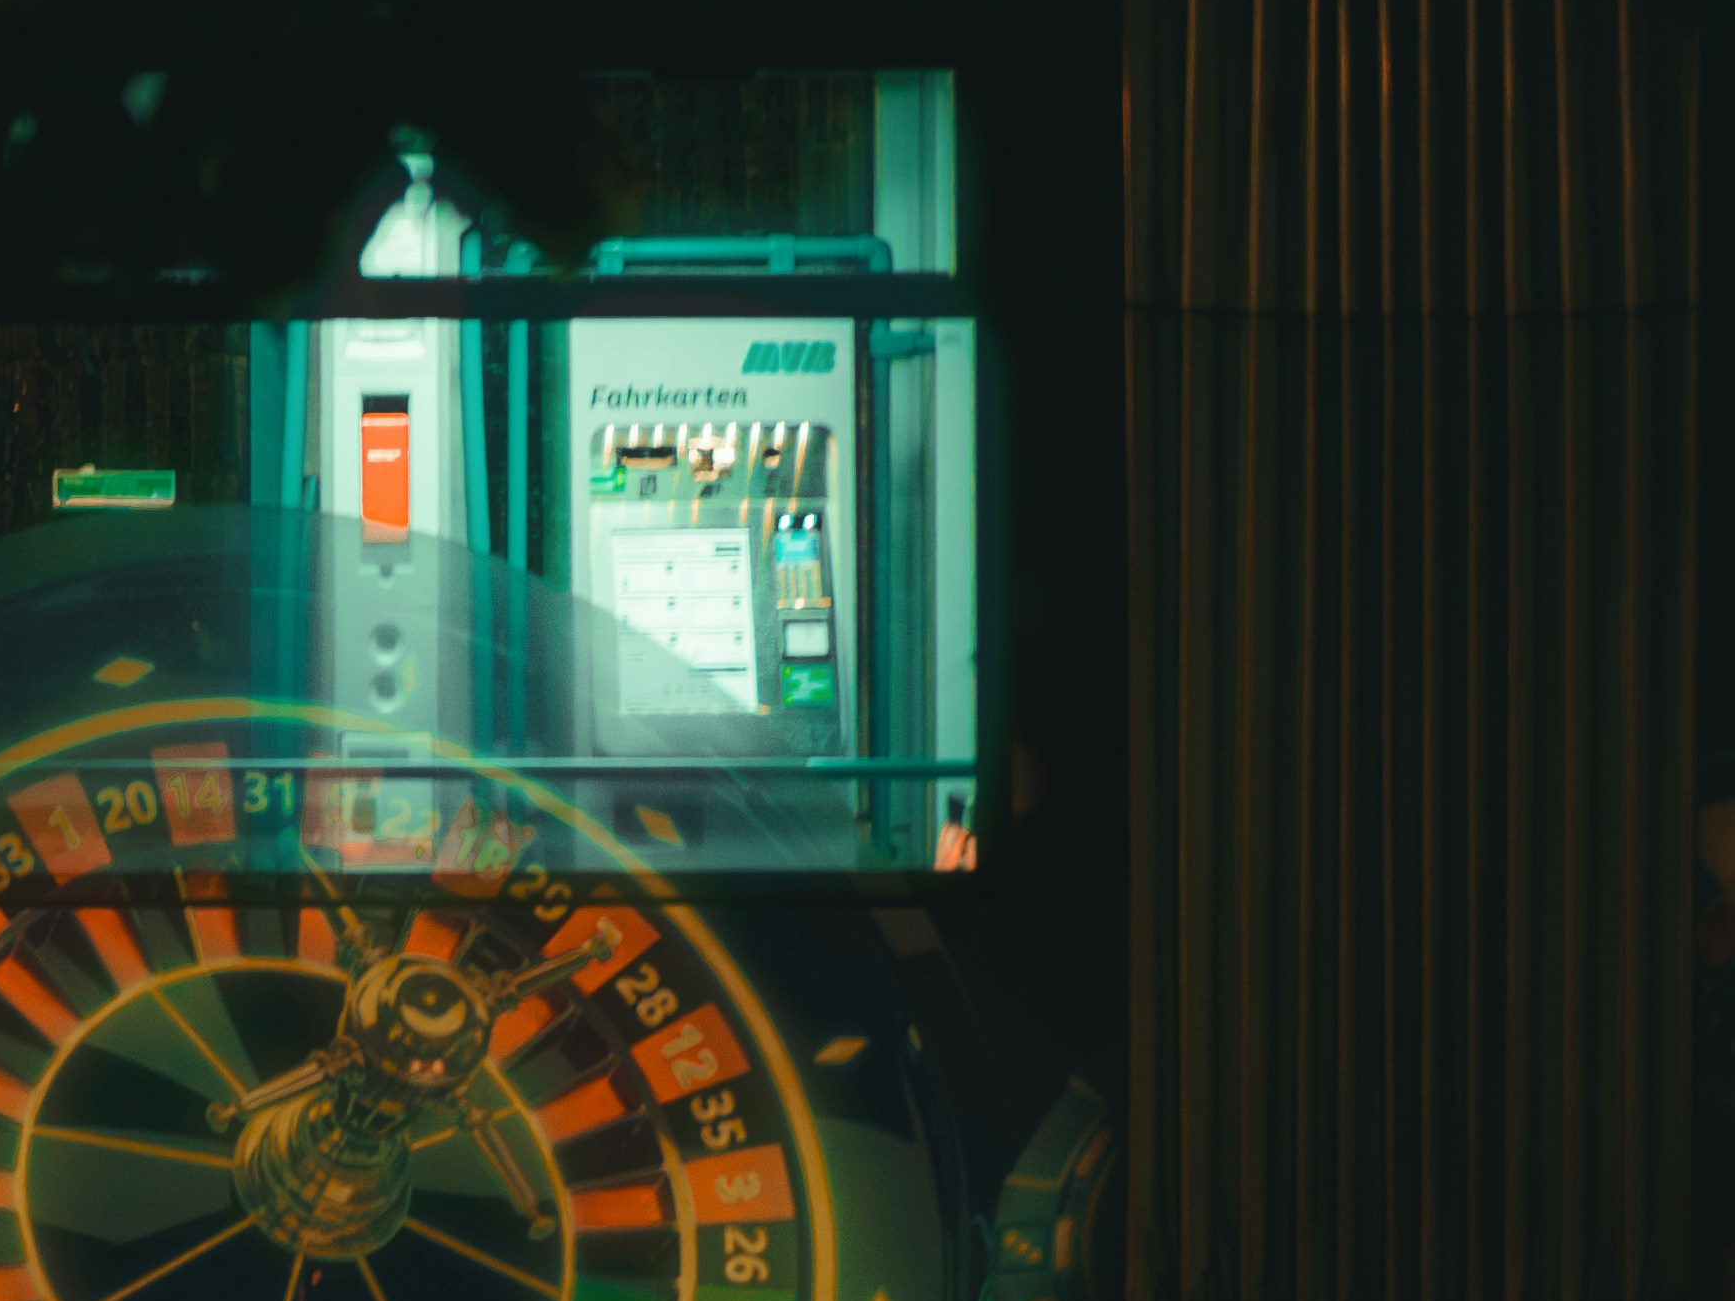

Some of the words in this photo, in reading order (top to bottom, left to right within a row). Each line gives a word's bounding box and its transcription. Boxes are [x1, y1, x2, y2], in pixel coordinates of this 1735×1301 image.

[590, 383, 749, 410] Fahrkarten
[96, 780, 157, 833] 20
[166, 772, 226, 816] 14
[242, 770, 293, 814] 31
[47, 802, 82, 851] 1
[614, 962, 679, 1028] 28
[661, 1023, 719, 1091] 12
[689, 1088, 748, 1151] 35
[713, 1170, 762, 1206] 3
[722, 1226, 770, 1285] 26
